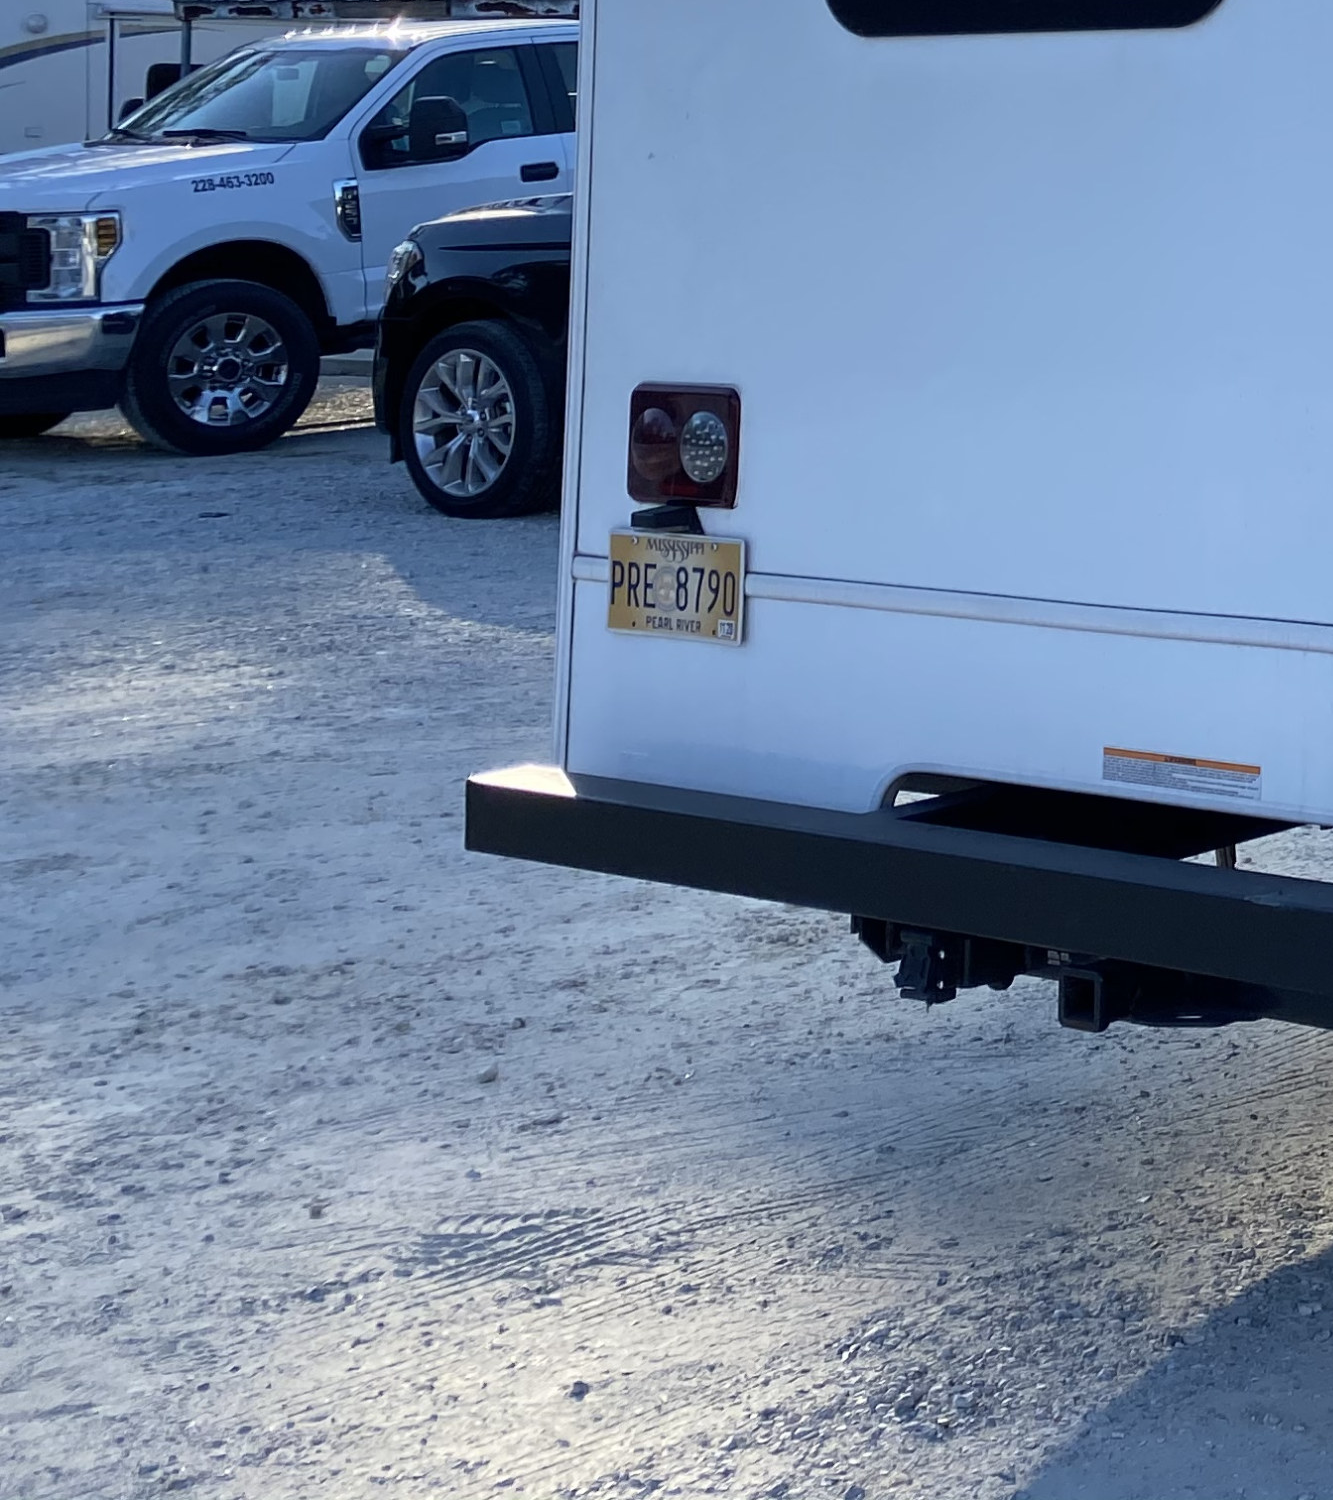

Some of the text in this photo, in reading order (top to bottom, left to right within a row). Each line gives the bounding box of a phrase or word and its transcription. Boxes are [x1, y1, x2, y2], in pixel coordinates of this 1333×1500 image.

[191, 171, 275, 193] 228-463-3200
[646, 538, 705, 563] MISSISSIPPI
[610, 560, 736, 617] PRE 8790
[646, 615, 673, 629] PEARL
[676, 617, 701, 633] RIVER
